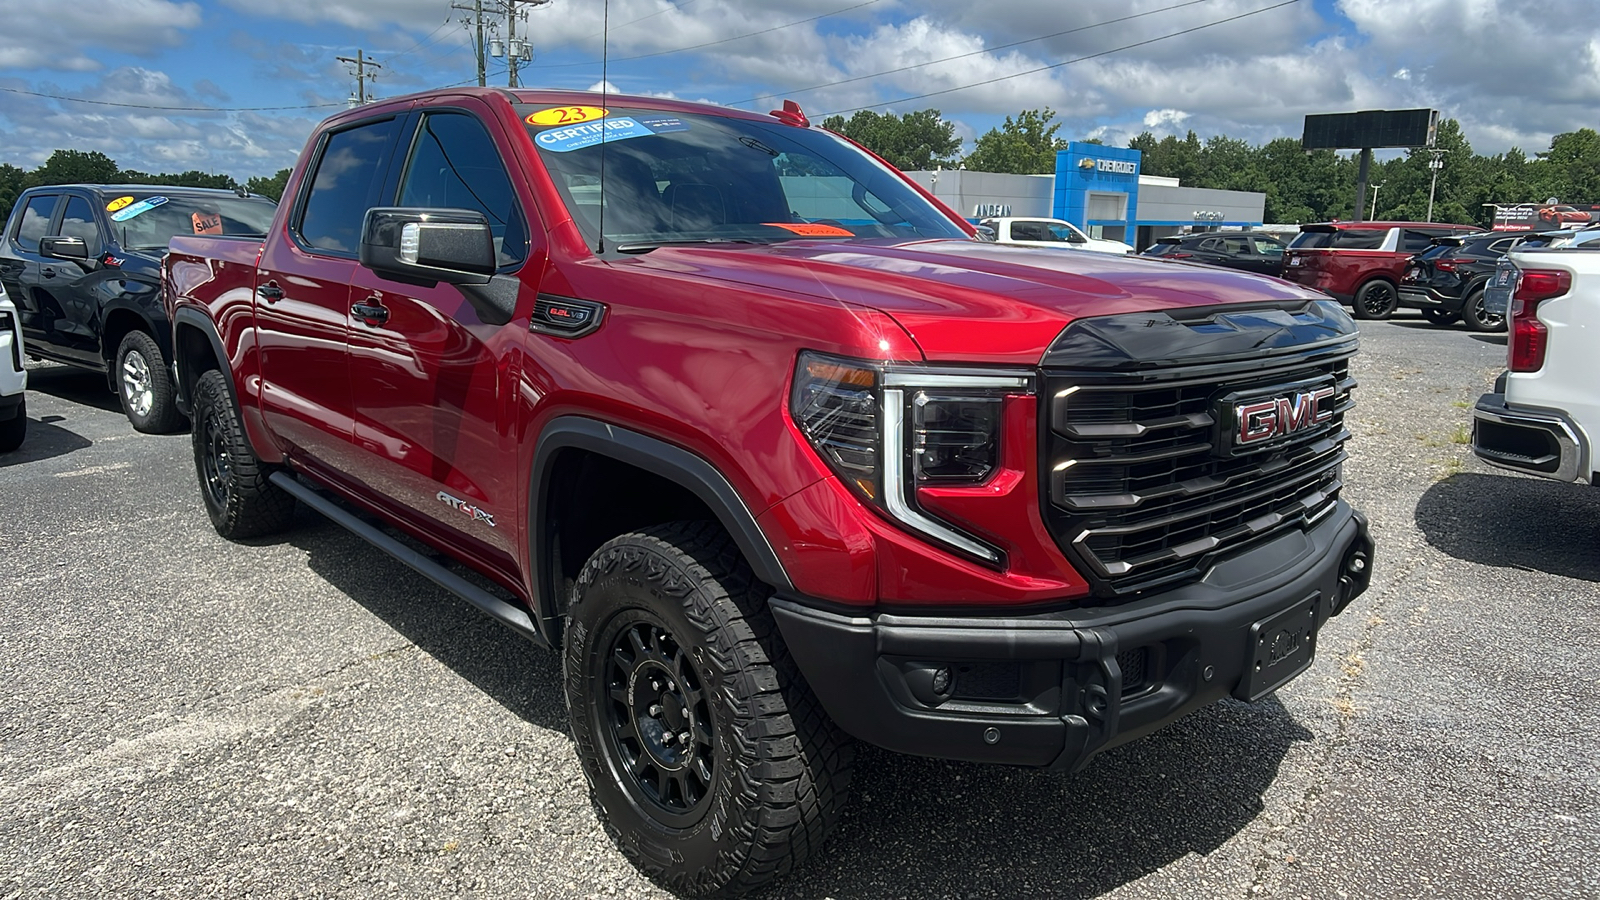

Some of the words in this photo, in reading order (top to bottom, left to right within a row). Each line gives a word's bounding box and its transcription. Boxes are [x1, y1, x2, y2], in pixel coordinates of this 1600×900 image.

[552, 108, 587, 123] 23
[539, 119, 635, 143] CERTIFIED
[1097, 159, 1137, 174] CHEVROLET
[974, 204, 1012, 217] ANDEAN
[196, 217, 219, 232] SALE
[550, 308, 570, 317] 6.2L
[571, 311, 584, 320] V8
[1235, 387, 1334, 444] GMC
[436, 490, 497, 527] AT4X
